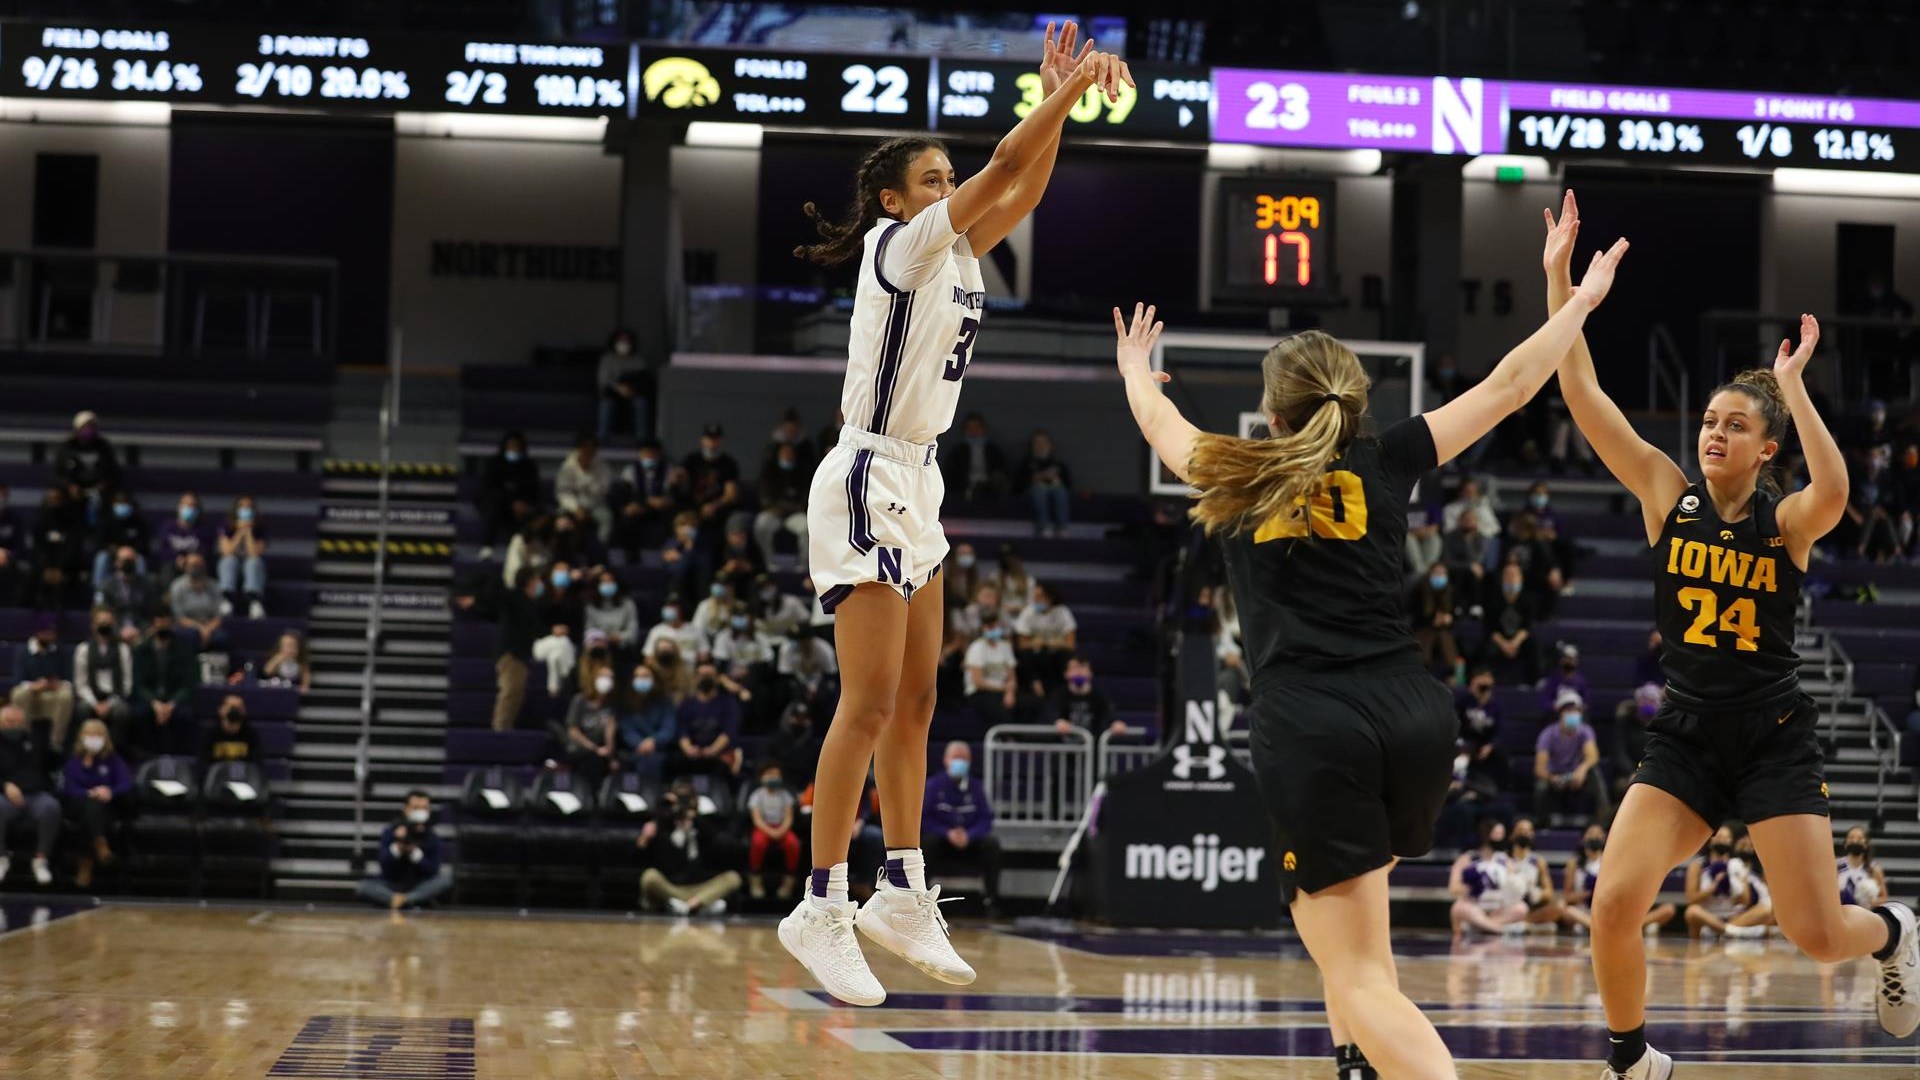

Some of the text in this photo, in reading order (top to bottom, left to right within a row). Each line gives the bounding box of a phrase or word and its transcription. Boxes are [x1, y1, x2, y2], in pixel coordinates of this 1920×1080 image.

[42, 27, 169, 51] FIELD GOALS
[258, 34, 370, 58] 3 POINT FG
[465, 42, 603, 67] FREE THROWS
[22, 54, 203, 92] 9/26 34.6%
[235, 61, 411, 99] 2/10 20.0%
[445, 69, 626, 107] 2/2 100.0%
[841, 64, 909, 113] 22
[948, 70, 995, 93] QTR
[941, 95, 989, 117] 2ND
[1013, 72, 1137, 124] 309
[1245, 81, 1310, 130] 23
[1432, 76, 1483, 155] N
[1551, 88, 1671, 112] FIELD GOALS
[1754, 97, 1855, 121] 3 POINT FG
[1519, 114, 1704, 152] 11/28 39.3%
[1736, 123, 1895, 161] 1/8 12.5%
[1255, 194, 1320, 230] 3:09
[1264, 231, 1311, 286] 17
[877, 547, 902, 584] N
[1667, 537, 1777, 592] IOWA
[1677, 586, 1760, 651] 24
[1185, 700, 1215, 743] N
[1125, 833, 1265, 892] meijer
